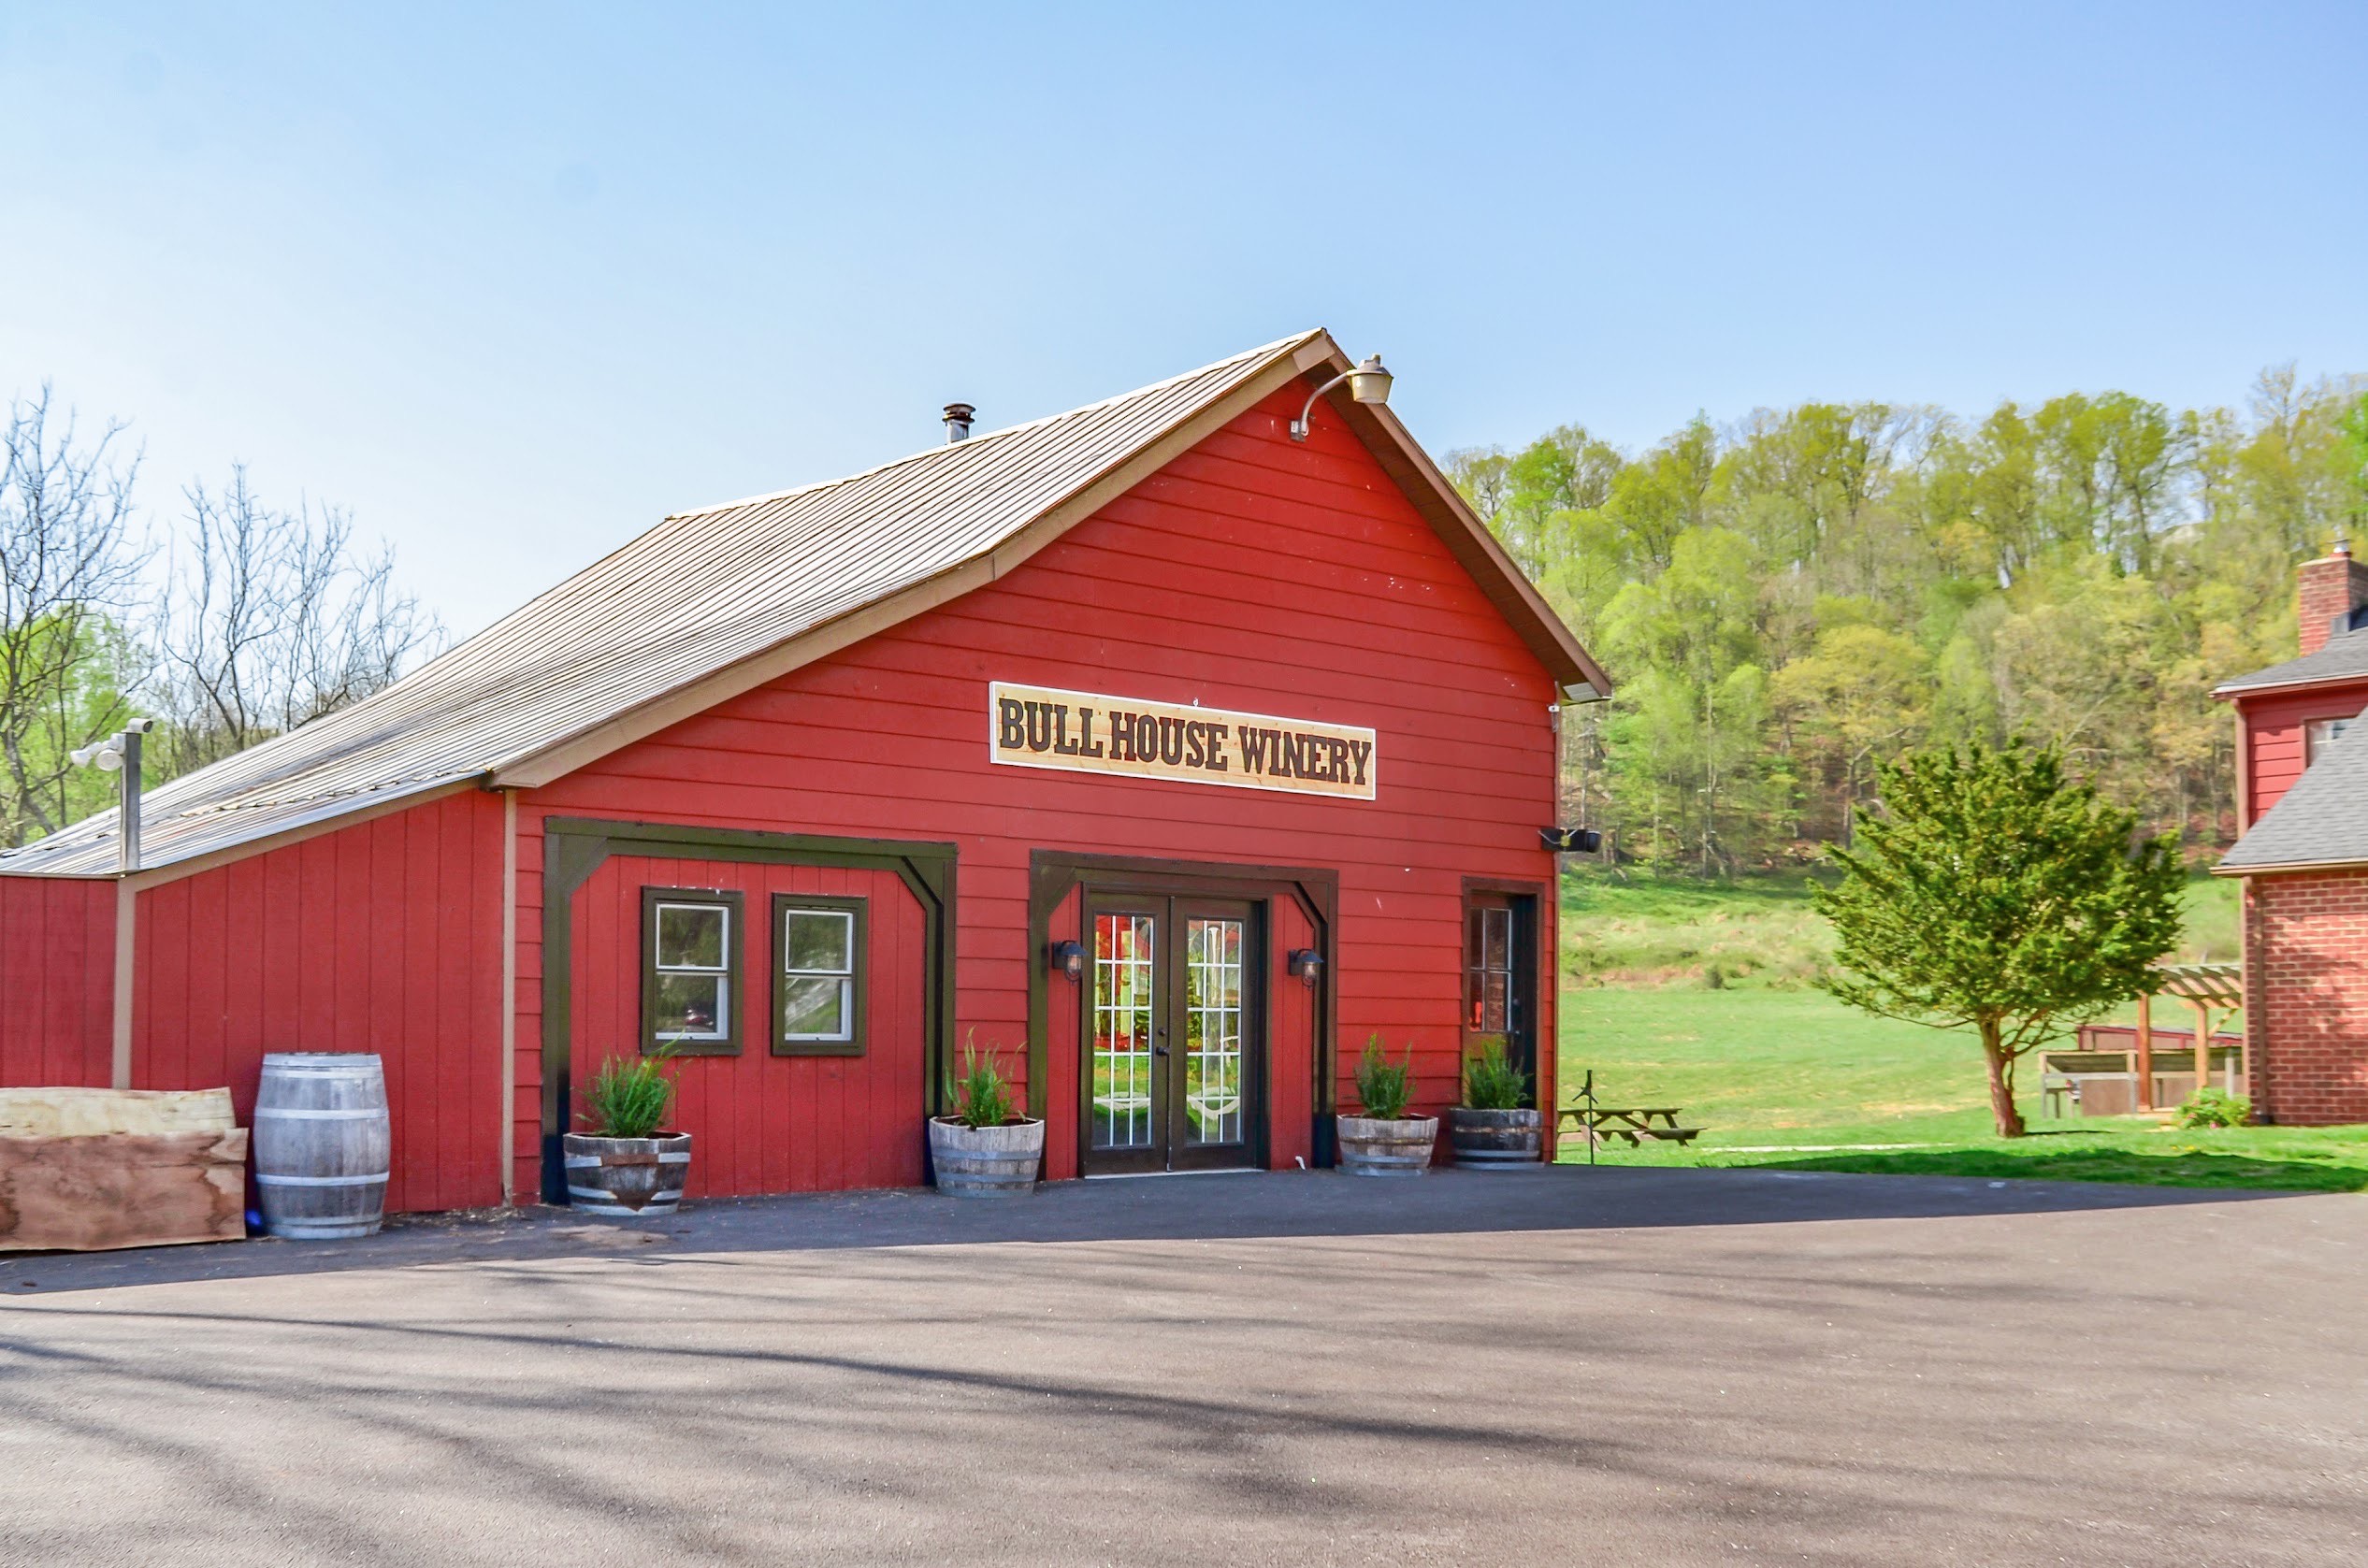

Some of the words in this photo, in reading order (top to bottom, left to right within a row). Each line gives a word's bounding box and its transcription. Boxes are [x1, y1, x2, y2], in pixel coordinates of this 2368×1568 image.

[999, 698, 1104, 758] BULL
[1109, 711, 1228, 771] HOUSE
[1238, 726, 1372, 785] WINERY
